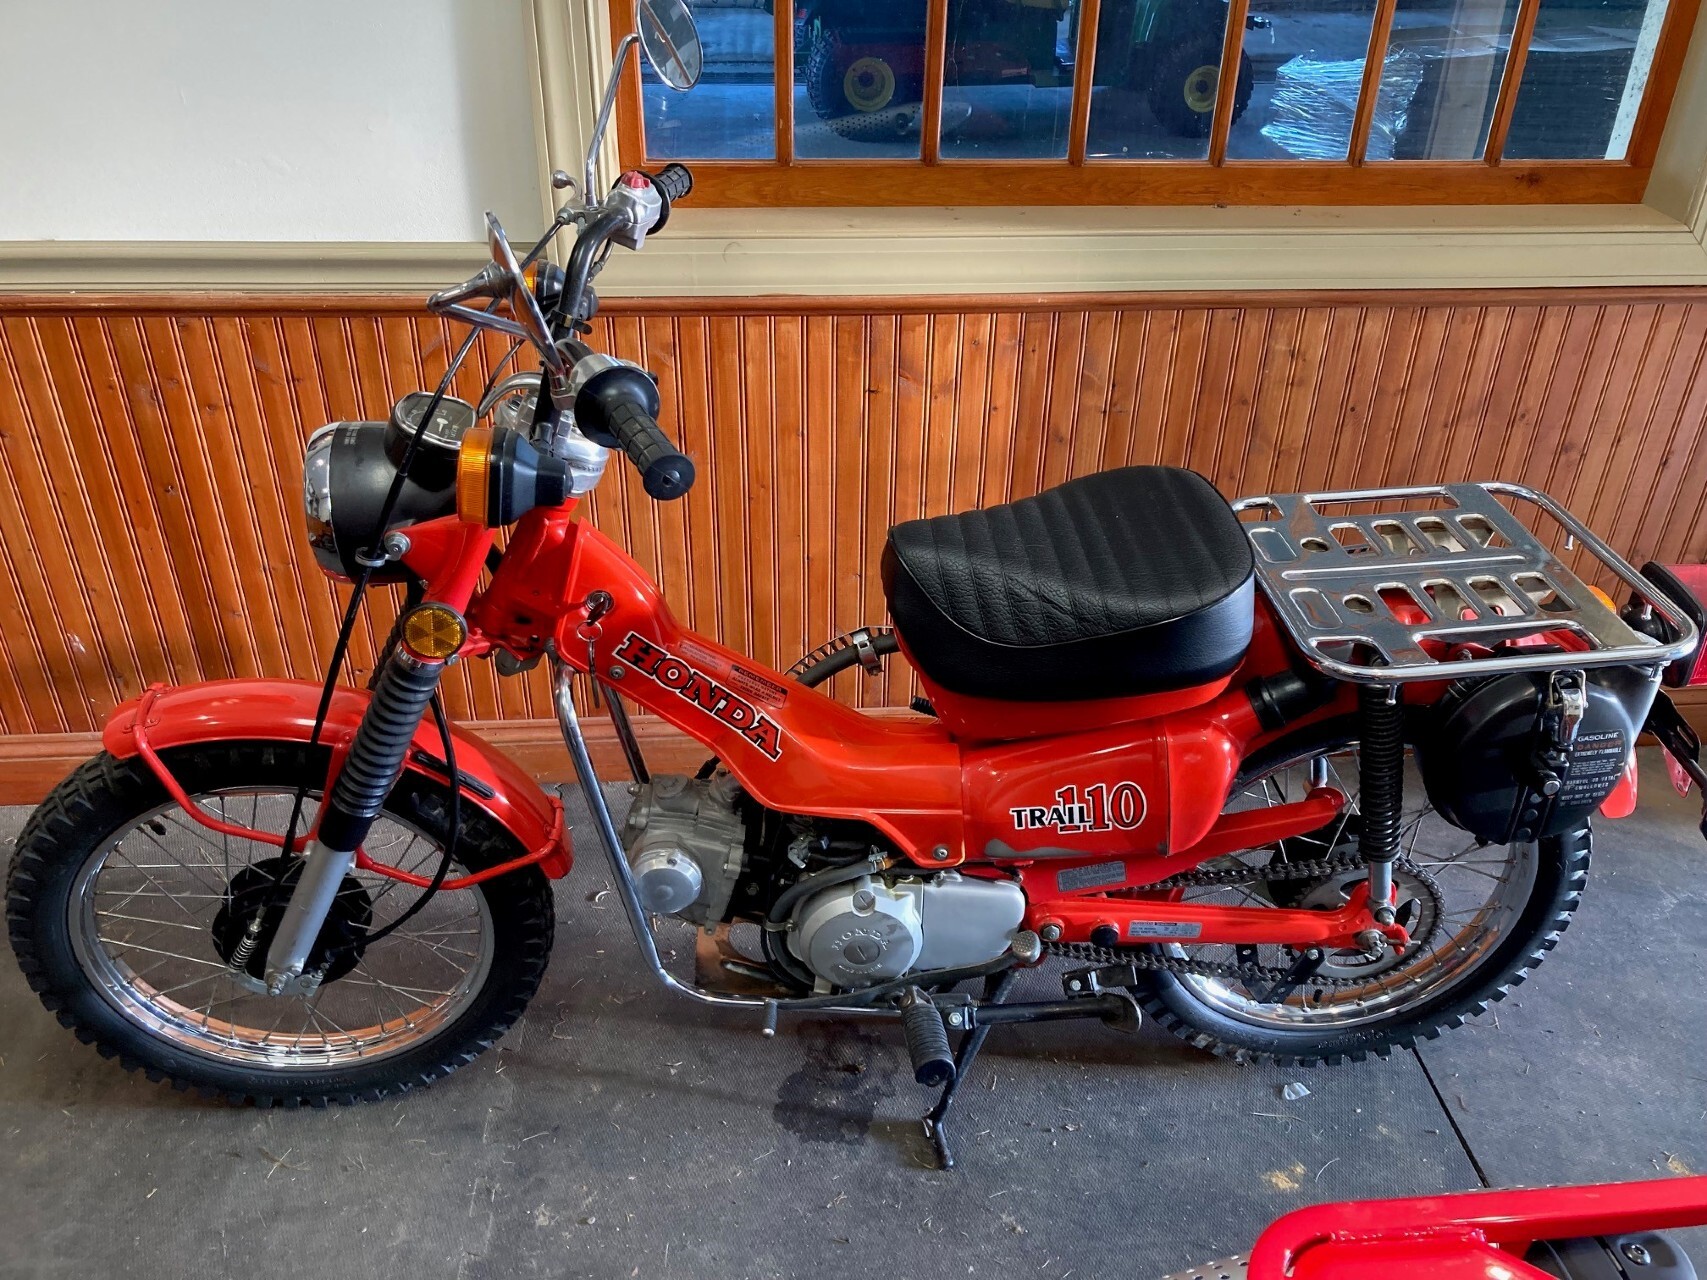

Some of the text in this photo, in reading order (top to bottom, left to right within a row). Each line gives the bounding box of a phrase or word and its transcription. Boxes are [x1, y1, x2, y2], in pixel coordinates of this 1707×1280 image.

[613, 631, 782, 762] HONDA
[1577, 740, 1622, 750] DANGER
[1578, 732, 1619, 742] GASOLINE
[1010, 781, 1147, 834] TRAIL 110
[832, 928, 889, 951] HONDA
